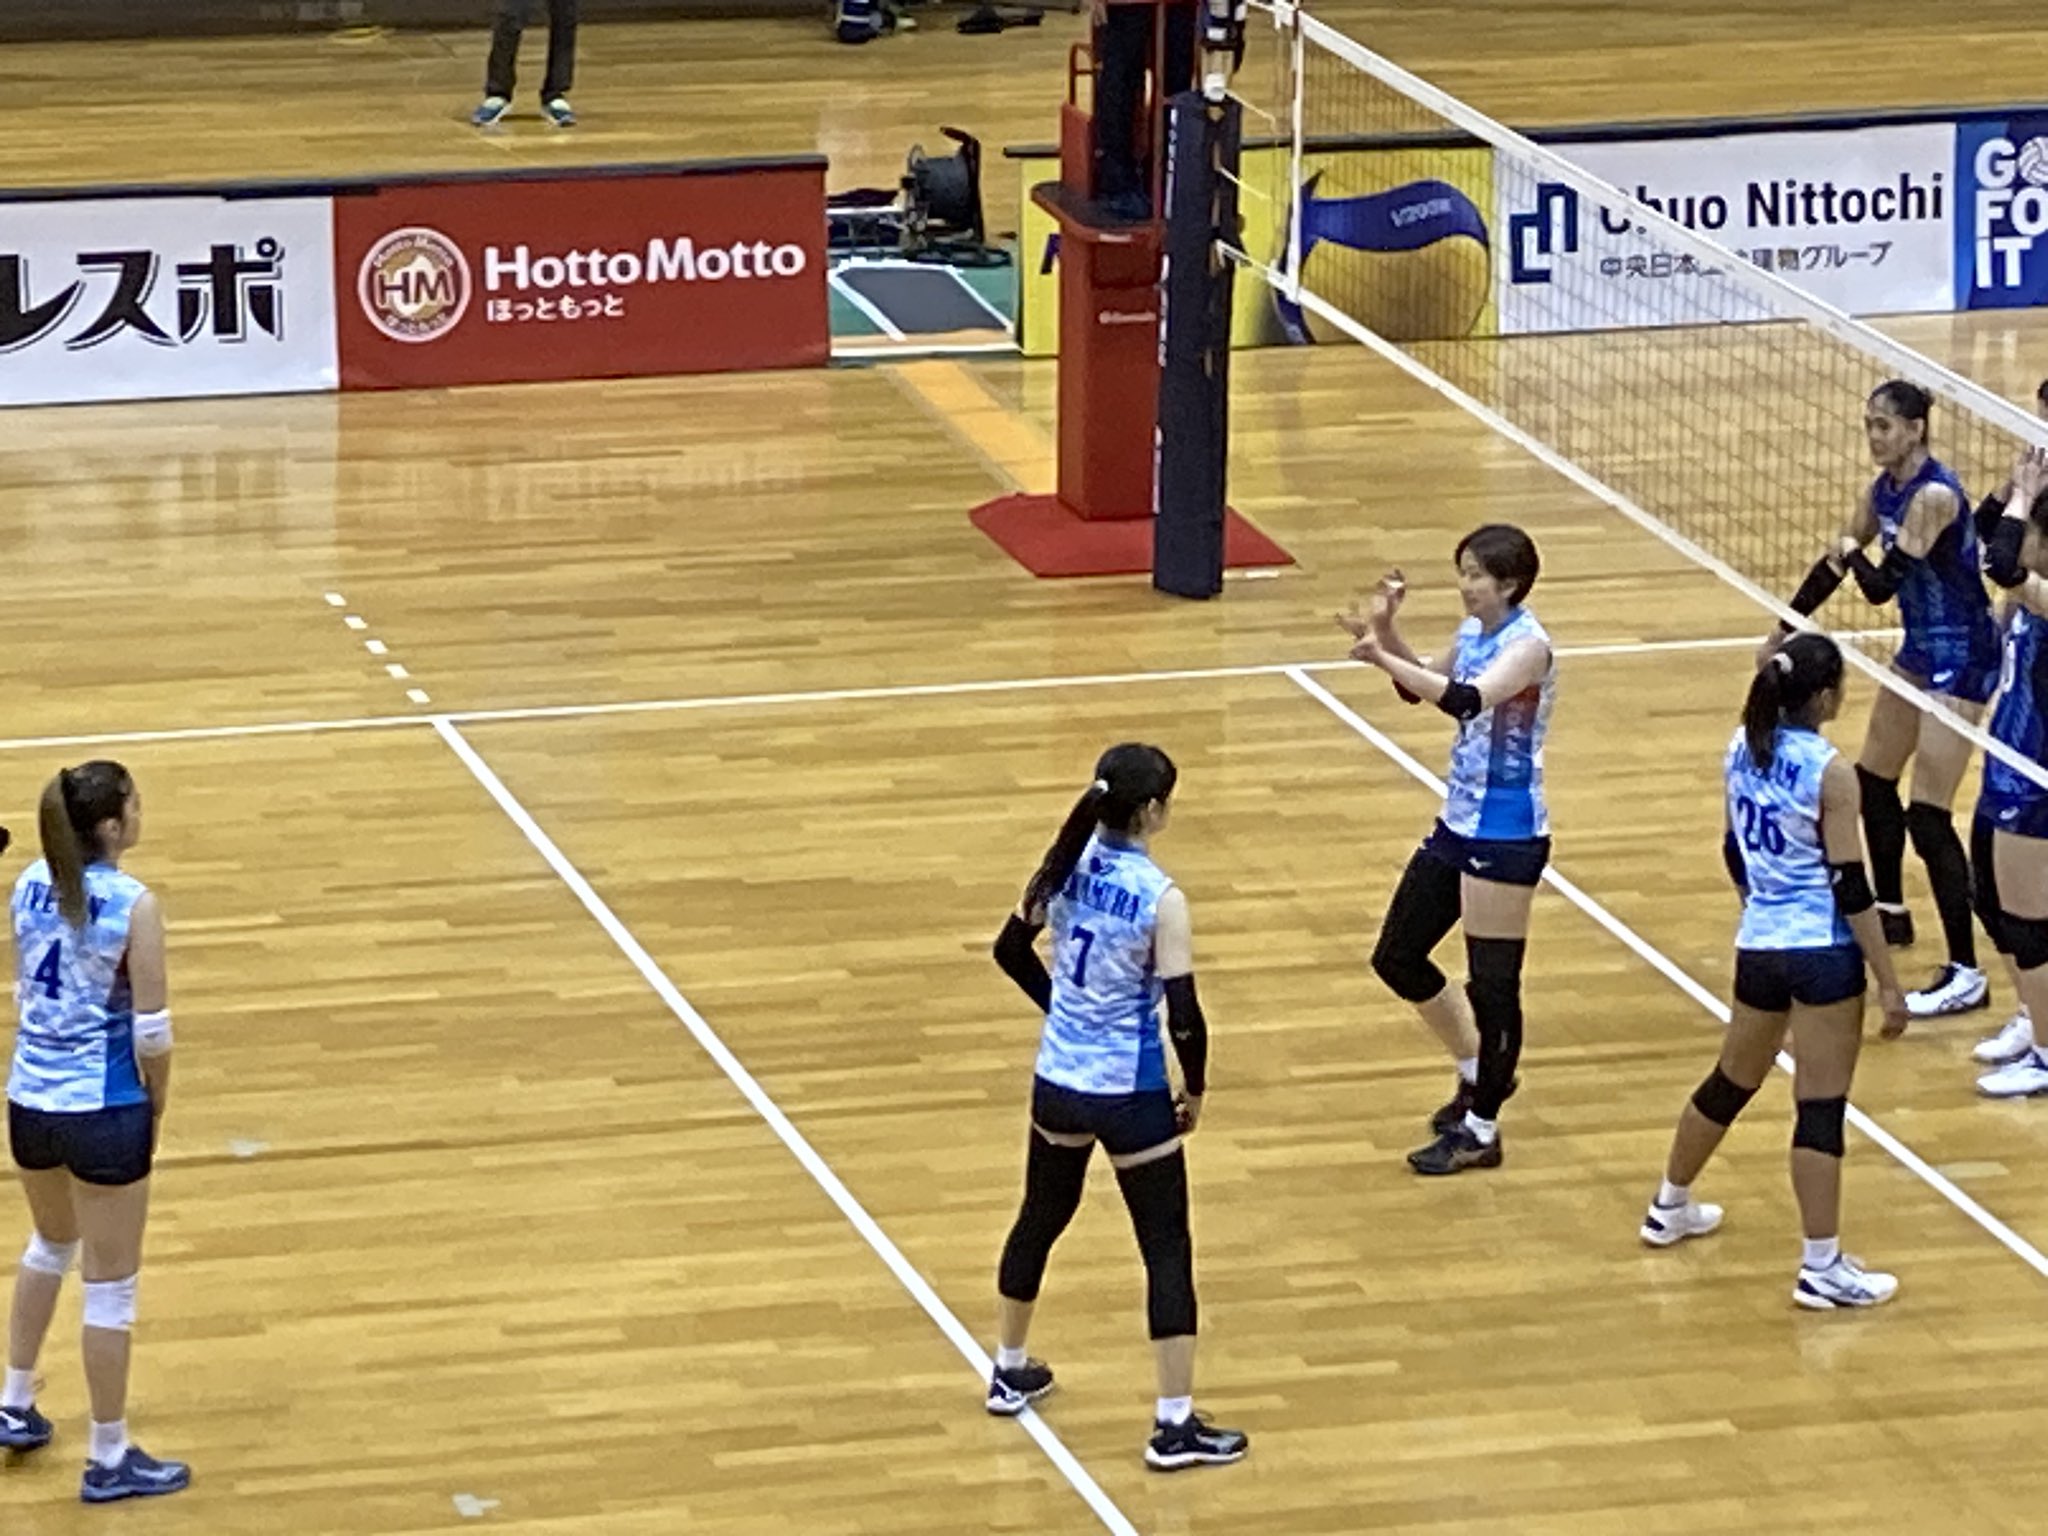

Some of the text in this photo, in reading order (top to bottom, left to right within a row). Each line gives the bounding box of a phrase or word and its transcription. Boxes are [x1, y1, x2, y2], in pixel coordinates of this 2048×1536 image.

[1600, 172, 1943, 234] Chuo Nittochi
[375, 268, 453, 307] HM
[1976, 236, 2033, 288] IT
[486, 293, 626, 322] ほっともっと
[1737, 796, 1786, 855] 26
[33, 938, 64, 1000] 4
[1070, 925, 1096, 988] 7
